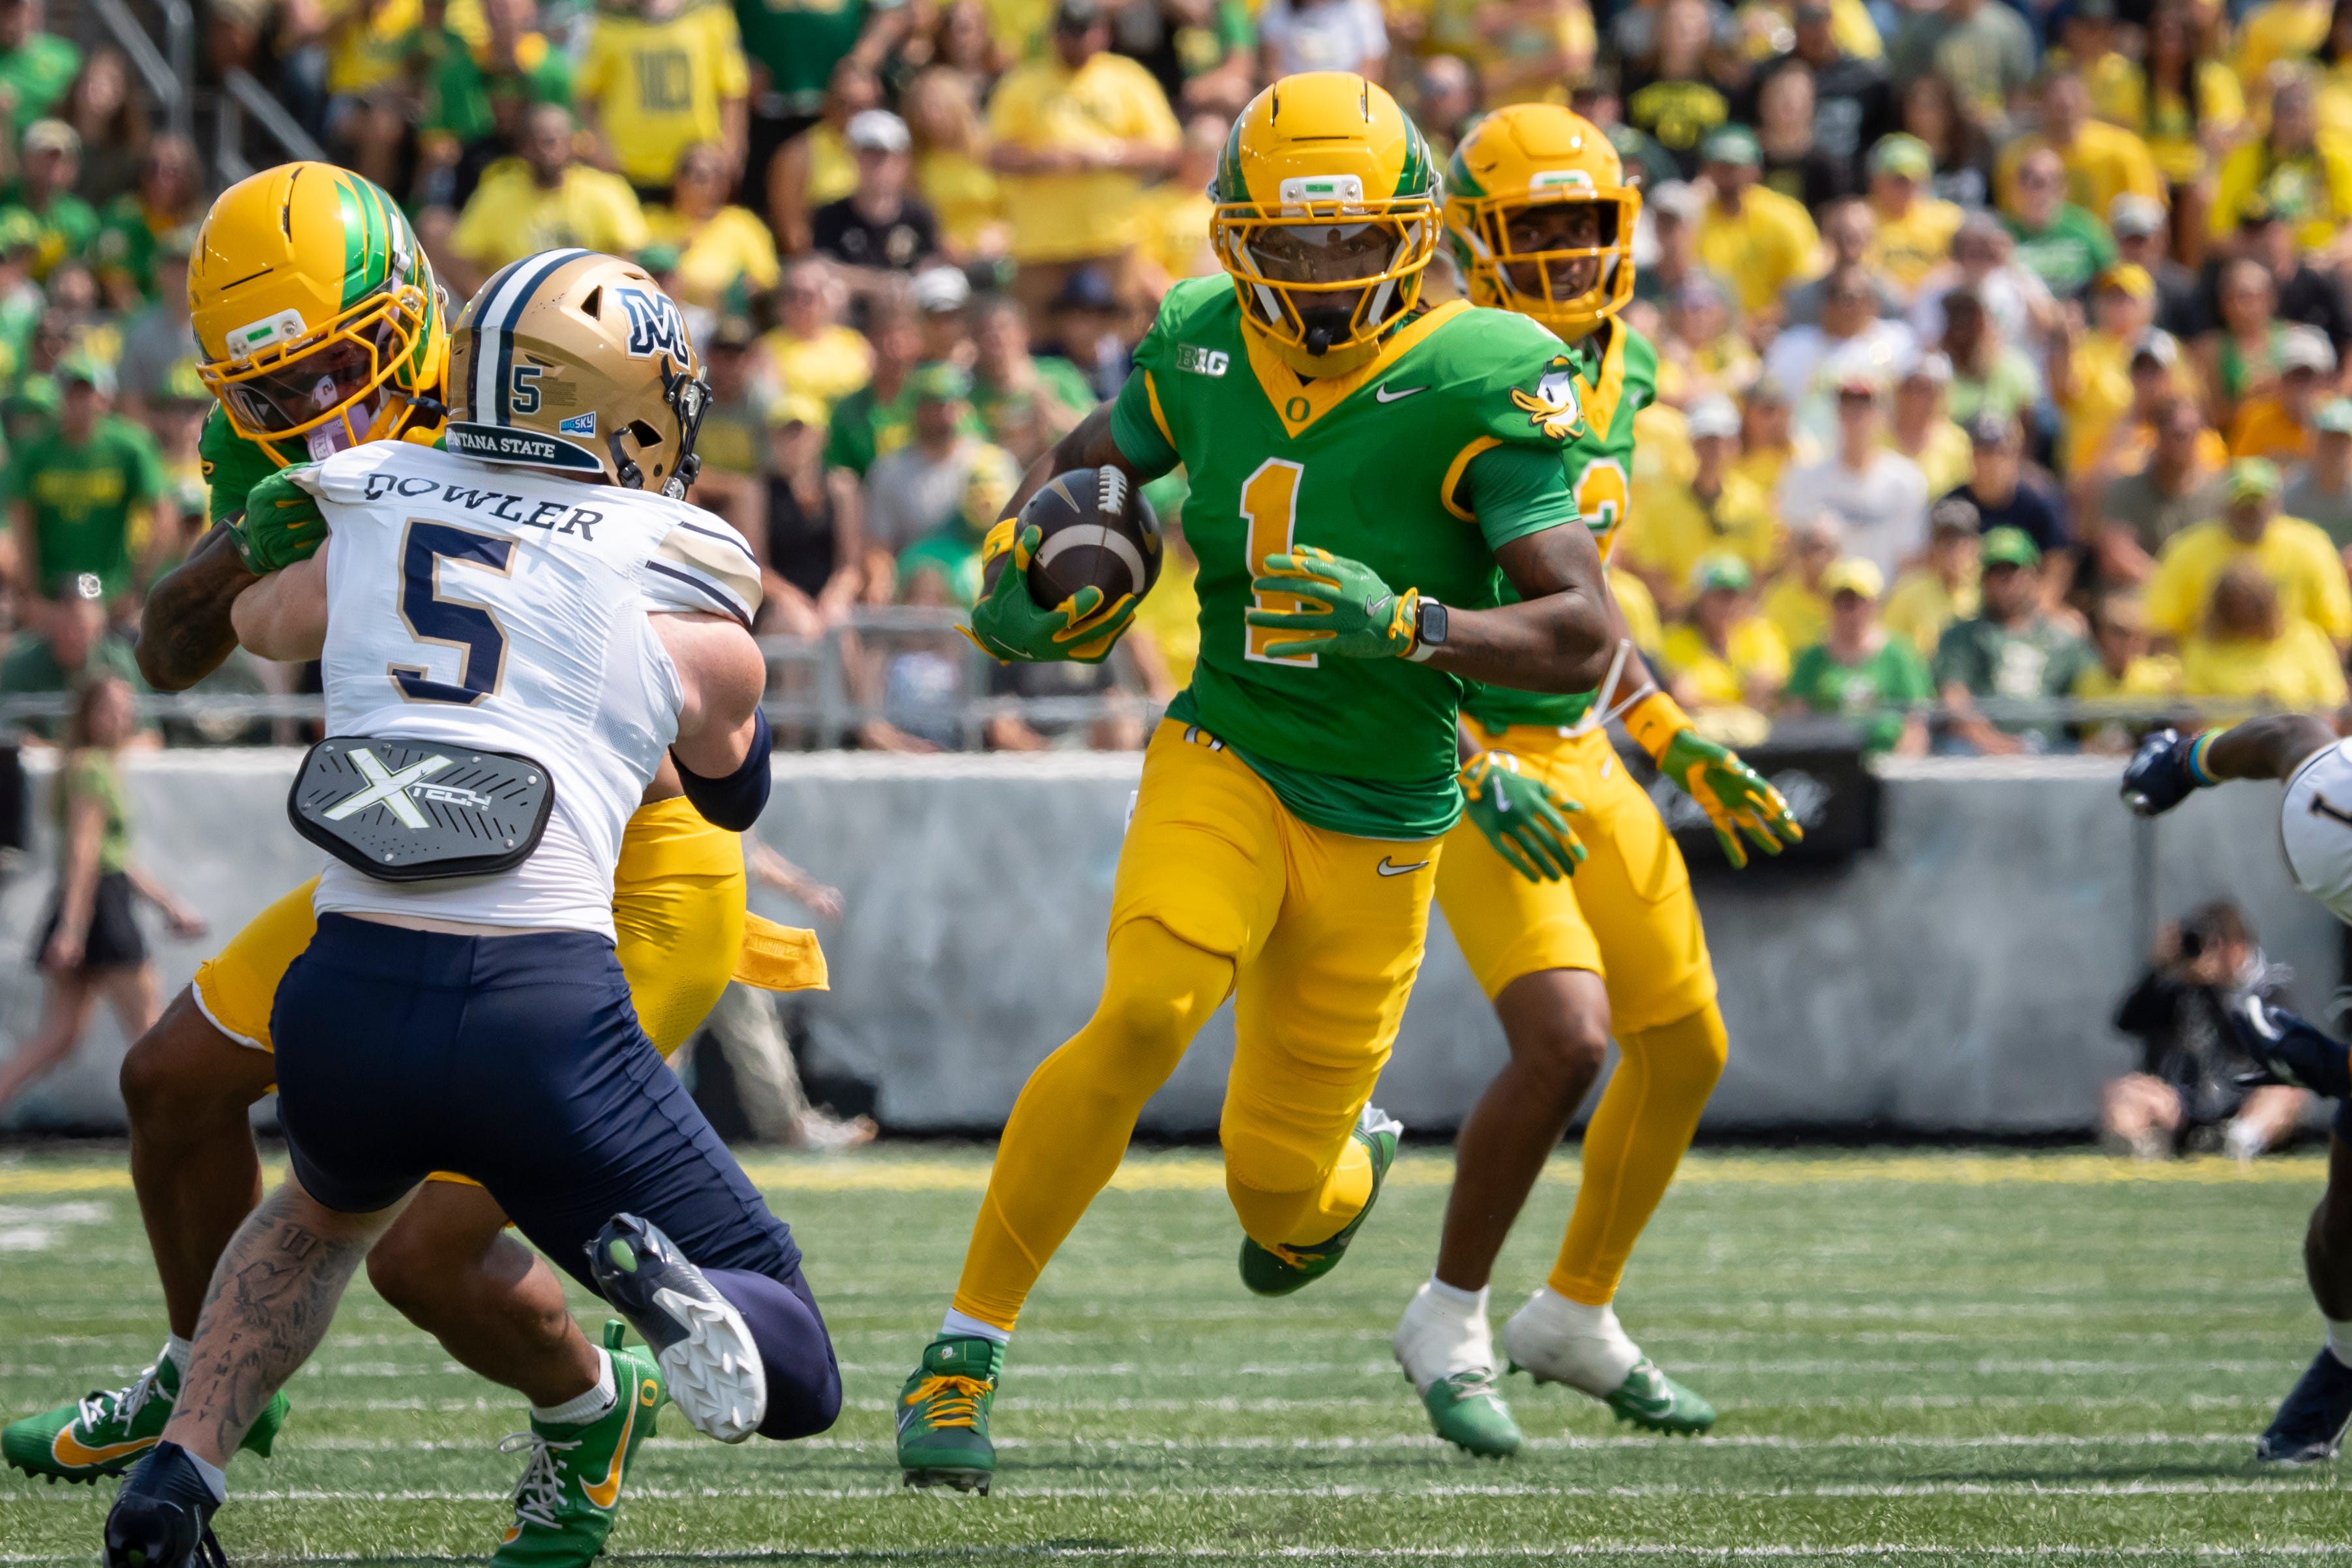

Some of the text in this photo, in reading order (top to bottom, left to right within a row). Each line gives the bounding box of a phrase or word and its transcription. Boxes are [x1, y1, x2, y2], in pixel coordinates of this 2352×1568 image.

[614, 288, 691, 370] M
[511, 364, 543, 415] 5
[1285, 396, 1311, 422] O
[501, 438, 556, 458] STATE
[364, 473, 603, 542] DOWLER
[1240, 456, 1318, 668] 1
[386, 517, 520, 707] 5
